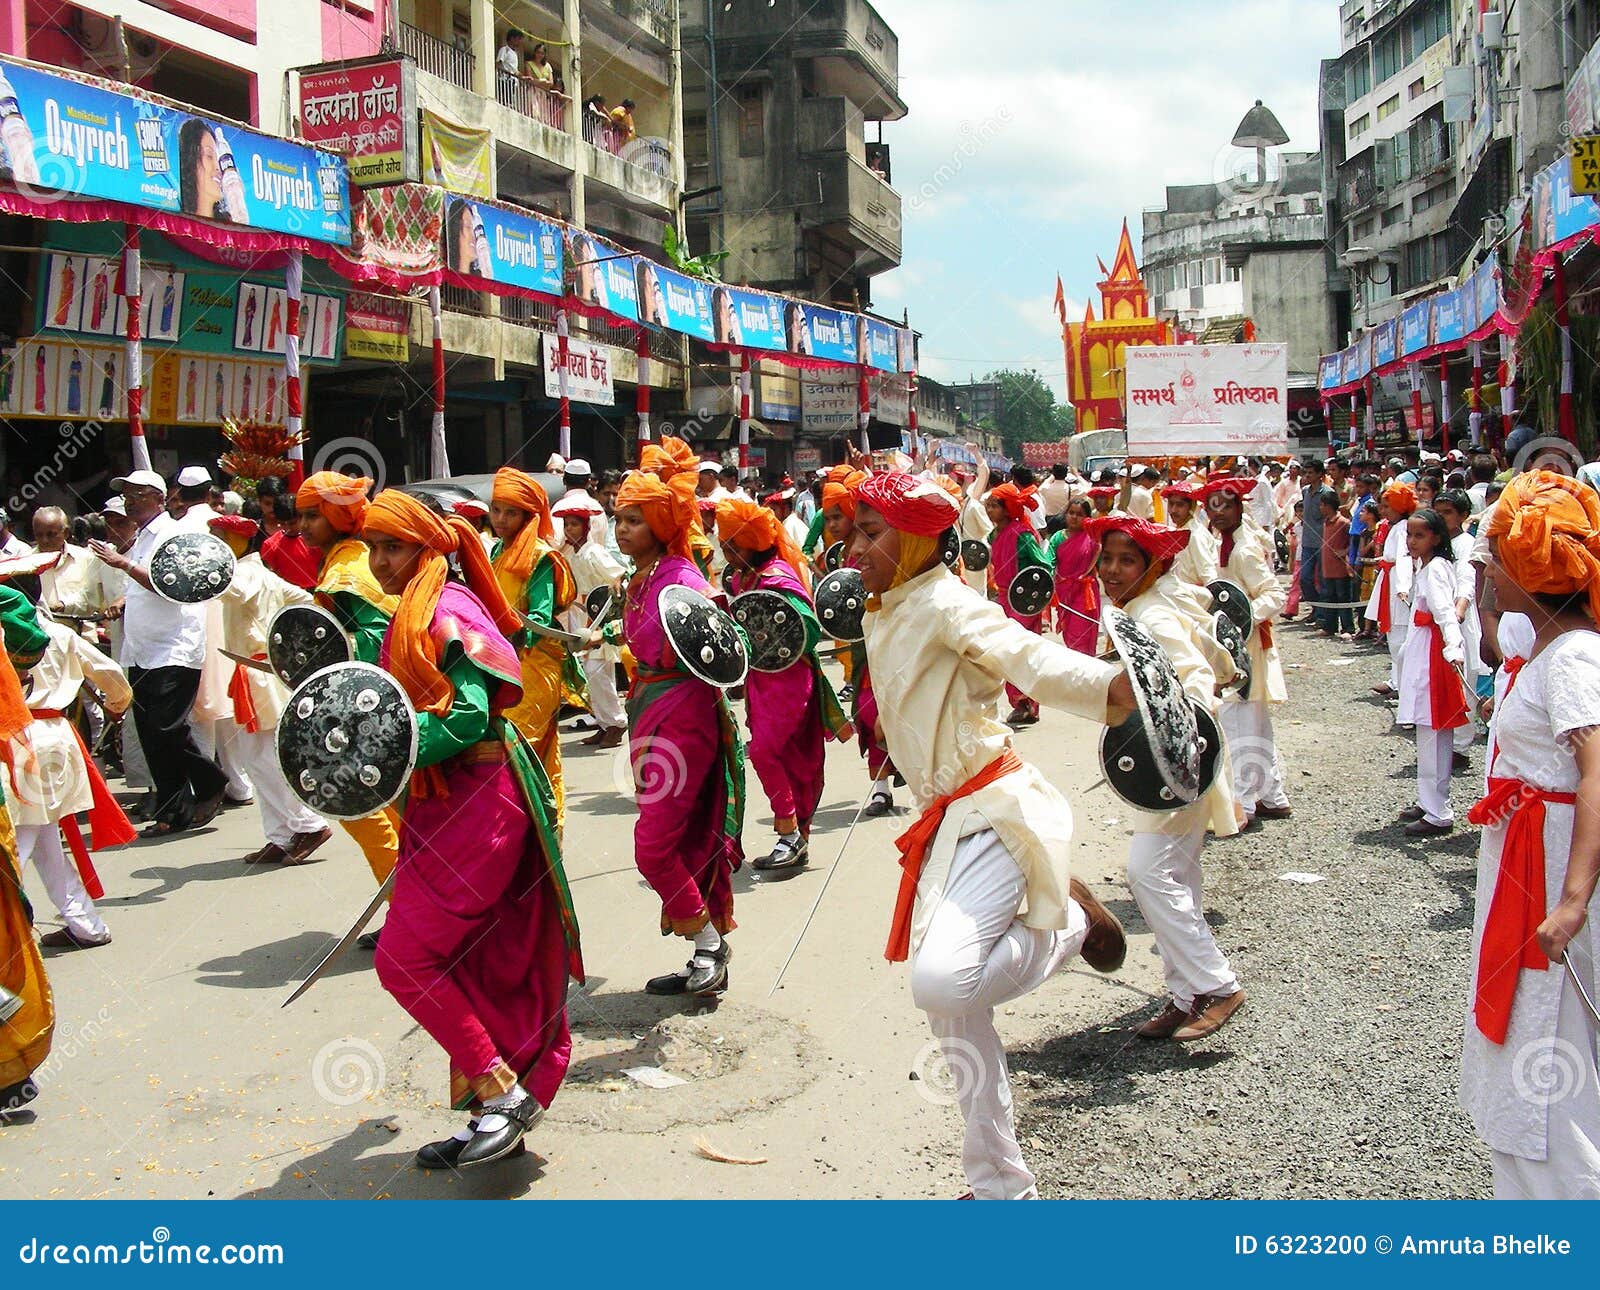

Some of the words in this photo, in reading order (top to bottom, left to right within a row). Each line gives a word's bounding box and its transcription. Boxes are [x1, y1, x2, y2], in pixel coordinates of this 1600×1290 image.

[303, 91, 360, 127] कल्पना
[363, 75, 398, 120] लॉज
[45, 98, 129, 171] Oxyrich
[1572, 140, 1600, 158] ST
[252, 153, 315, 211] Oxyrich
[1582, 159, 1600, 170] FA
[141, 183, 178, 200] recharge
[496, 223, 537, 269] Oxyrich
[1132, 382, 1175, 406] समर्थ
[1213, 381, 1279, 406] प्रतिष्ठान
